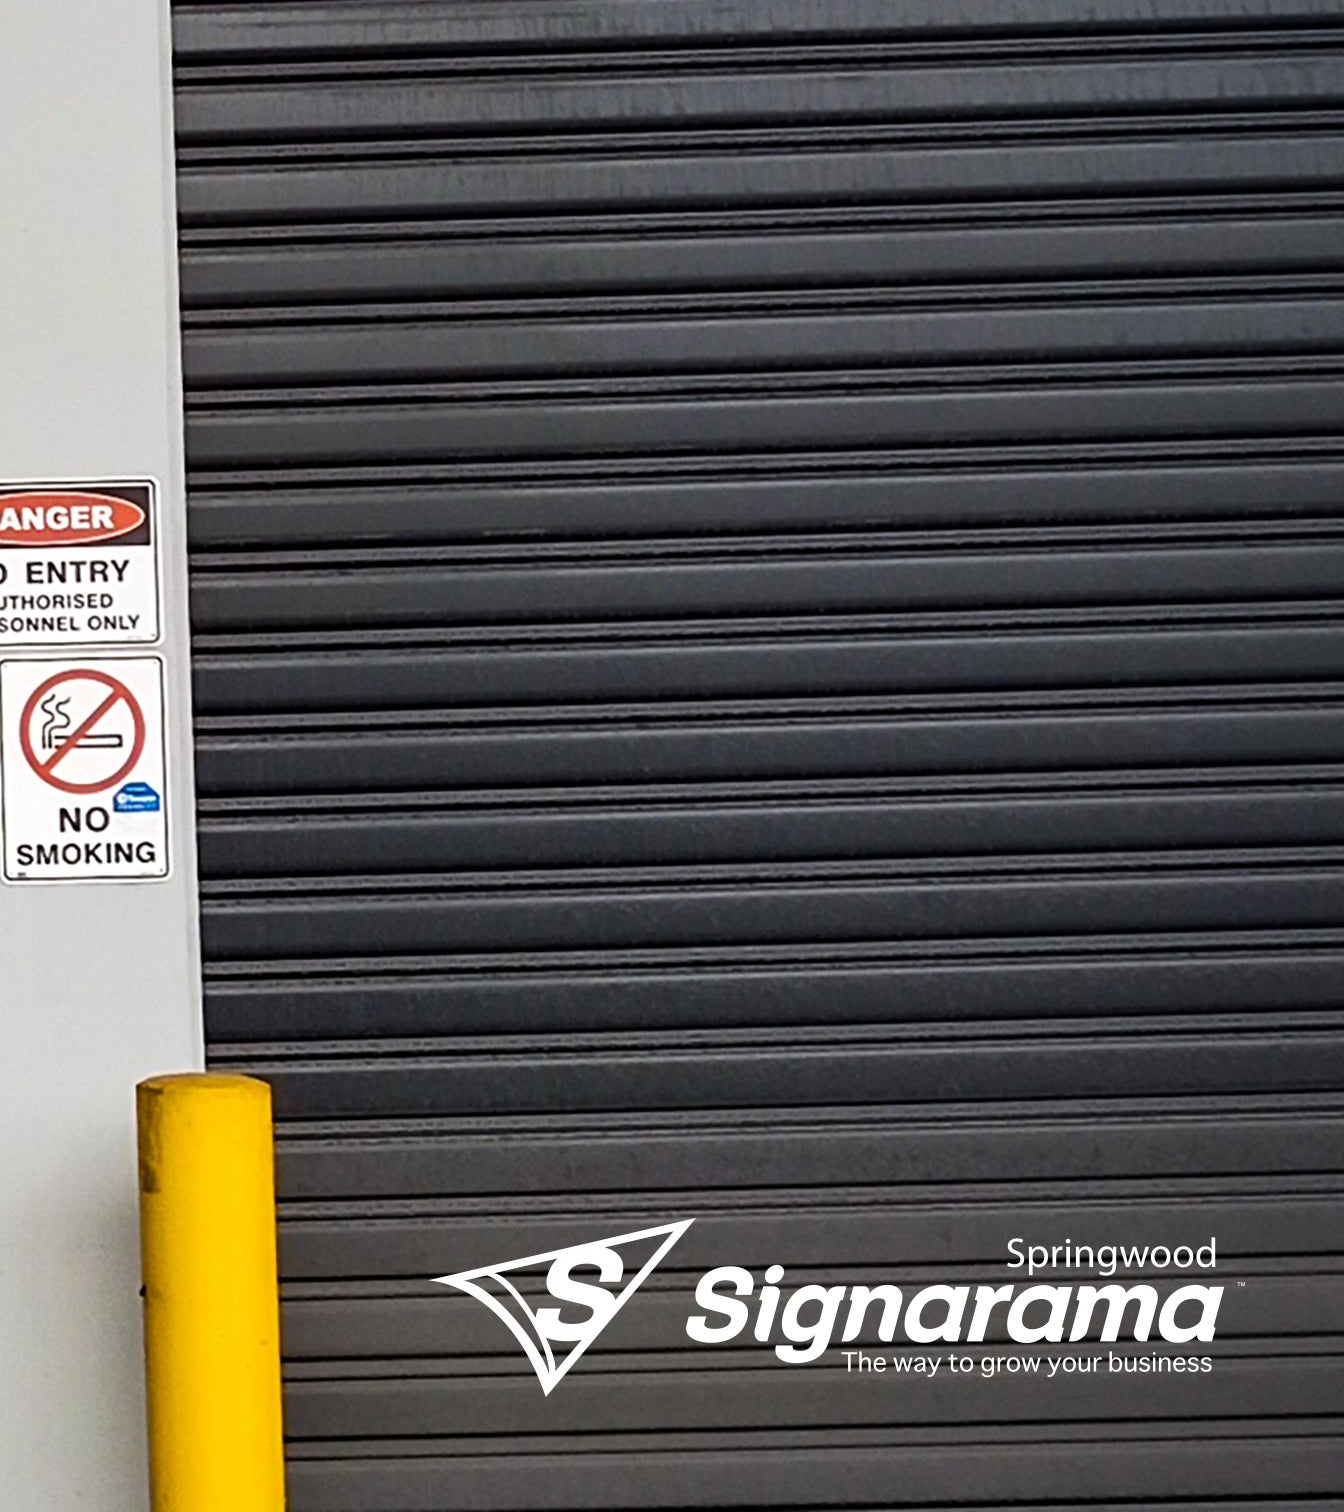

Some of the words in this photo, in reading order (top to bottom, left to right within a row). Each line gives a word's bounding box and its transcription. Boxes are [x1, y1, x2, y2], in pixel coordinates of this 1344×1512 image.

[26, 559, 131, 584] ENTRY
[87, 614, 141, 631] ONLY
[59, 806, 111, 833] NO
[16, 841, 157, 867] SMOKING
